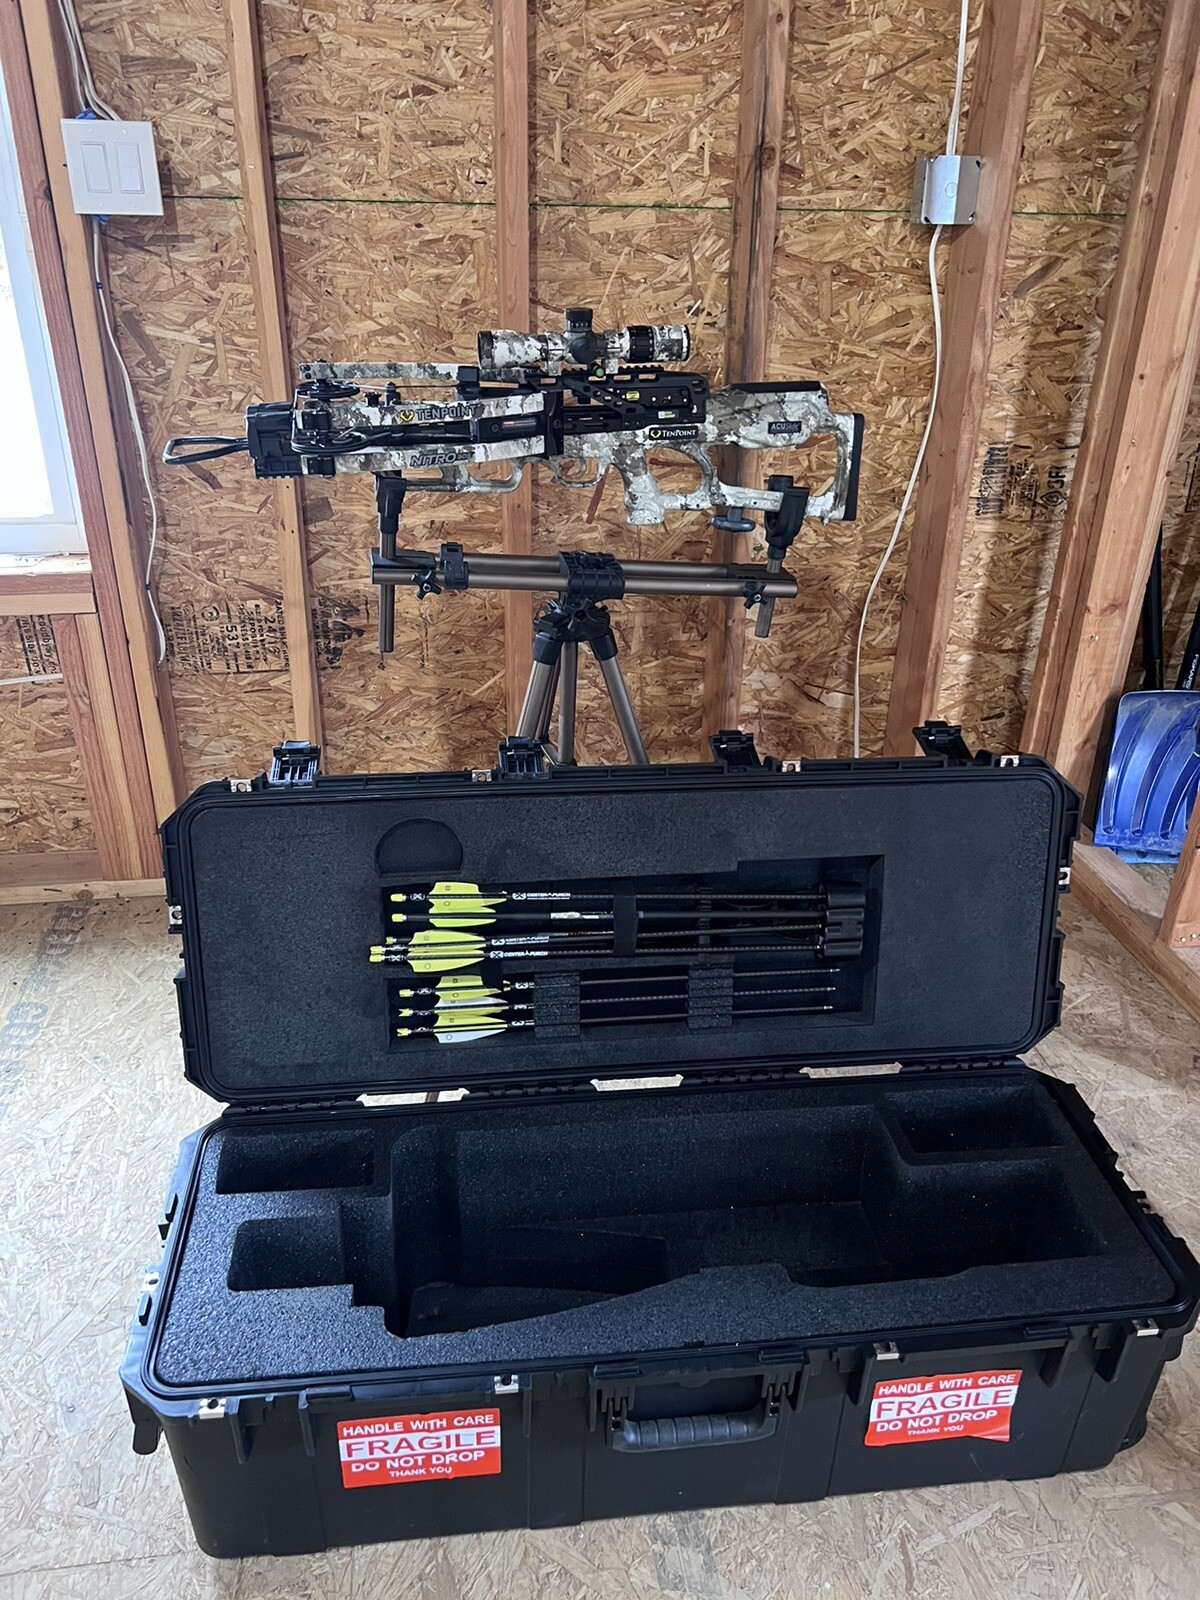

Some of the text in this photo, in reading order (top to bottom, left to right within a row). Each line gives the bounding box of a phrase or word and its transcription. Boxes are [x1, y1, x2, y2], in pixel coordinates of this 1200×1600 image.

[416, 405, 476, 421] TENPOINT
[410, 452, 457, 467] NITRO
[878, 1374, 1016, 1396] HANDLE WITH CARE
[876, 1389, 1013, 1419] FRAGILE
[343, 1414, 495, 1437] HANDLE WITH CARE
[876, 1409, 998, 1432] DO NOT DROP
[907, 1424, 964, 1436] THANK YOU
[345, 1430, 496, 1458] FRAGILE
[351, 1450, 486, 1472] DO NOT DROP
[389, 1466, 452, 1478] THANK YOU
